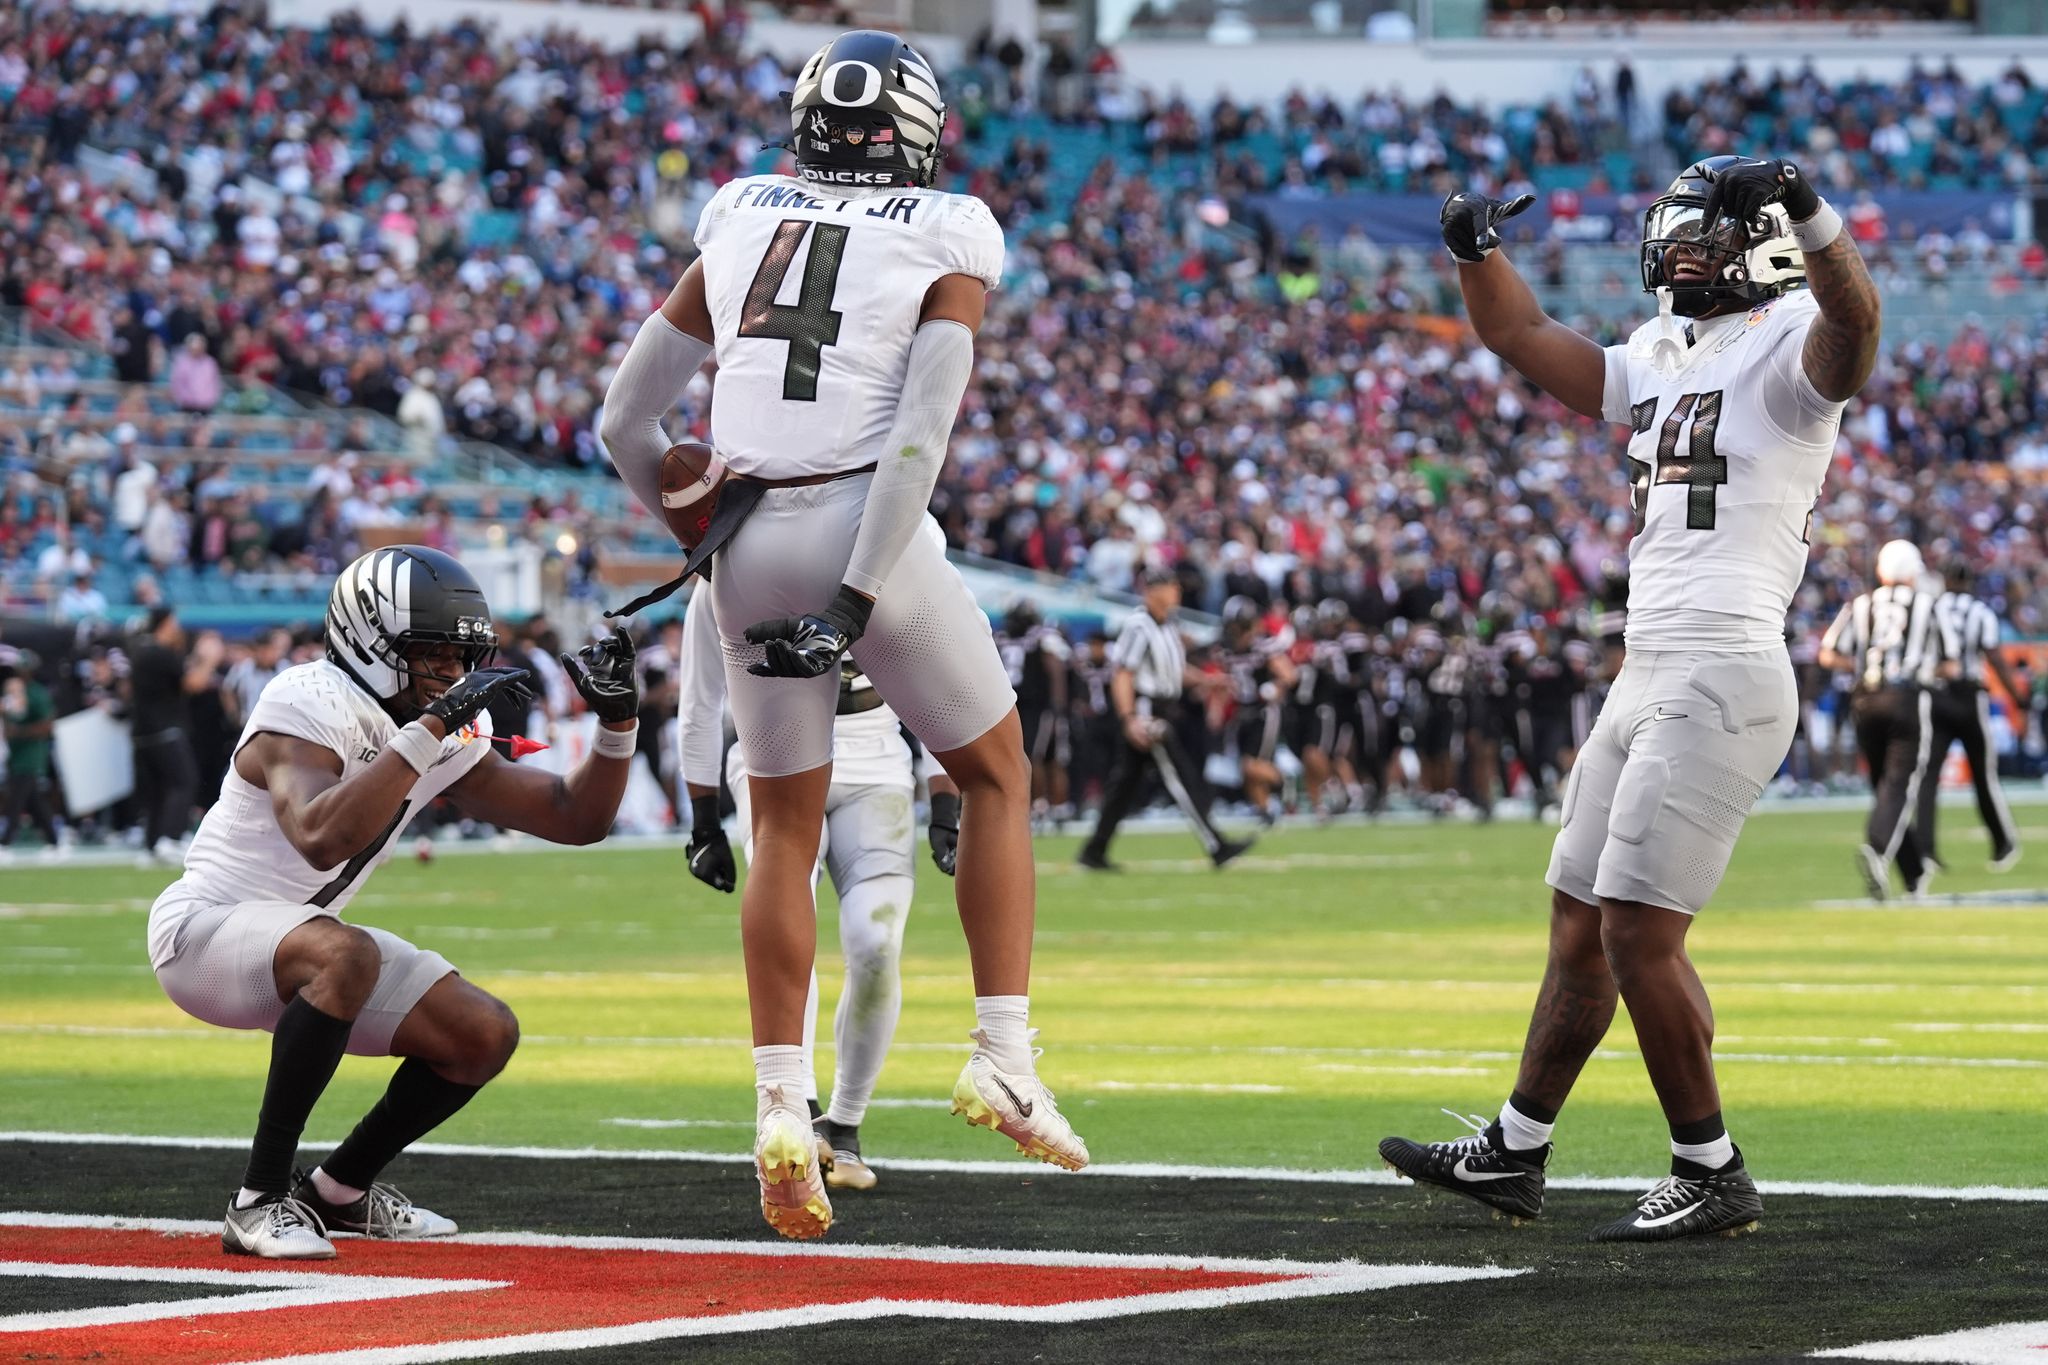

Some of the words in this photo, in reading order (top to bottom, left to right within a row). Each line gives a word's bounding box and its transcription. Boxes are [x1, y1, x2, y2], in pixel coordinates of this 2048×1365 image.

[820, 60, 882, 107] O
[803, 168, 893, 184] DUCKS
[865, 197, 921, 224] JR
[737, 219, 851, 401] 4
